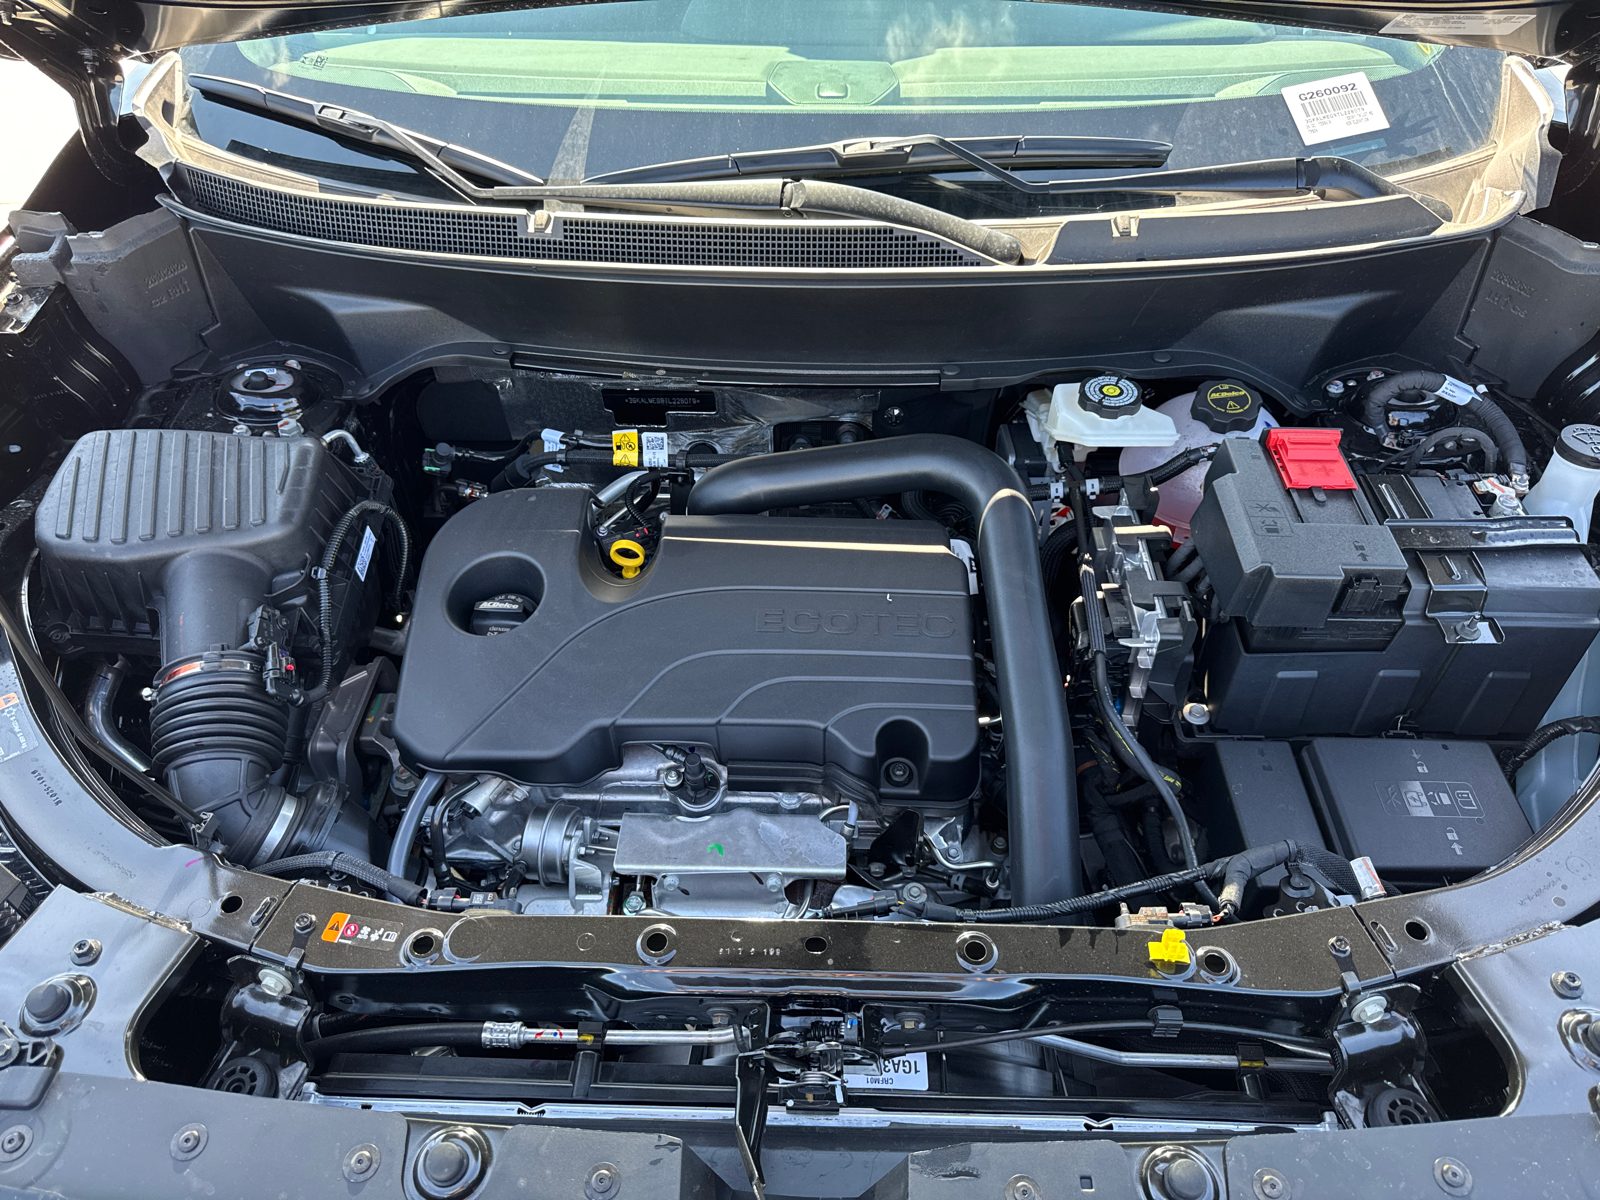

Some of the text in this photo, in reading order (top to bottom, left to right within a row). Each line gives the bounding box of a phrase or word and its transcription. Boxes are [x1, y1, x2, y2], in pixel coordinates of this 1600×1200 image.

[1298, 82, 1357, 101] G260092
[1210, 390, 1246, 399] ACDelco
[479, 601, 519, 609] ACDelco
[755, 609, 956, 638] ECOTEC
[883, 1059, 921, 1075] 1GA3
